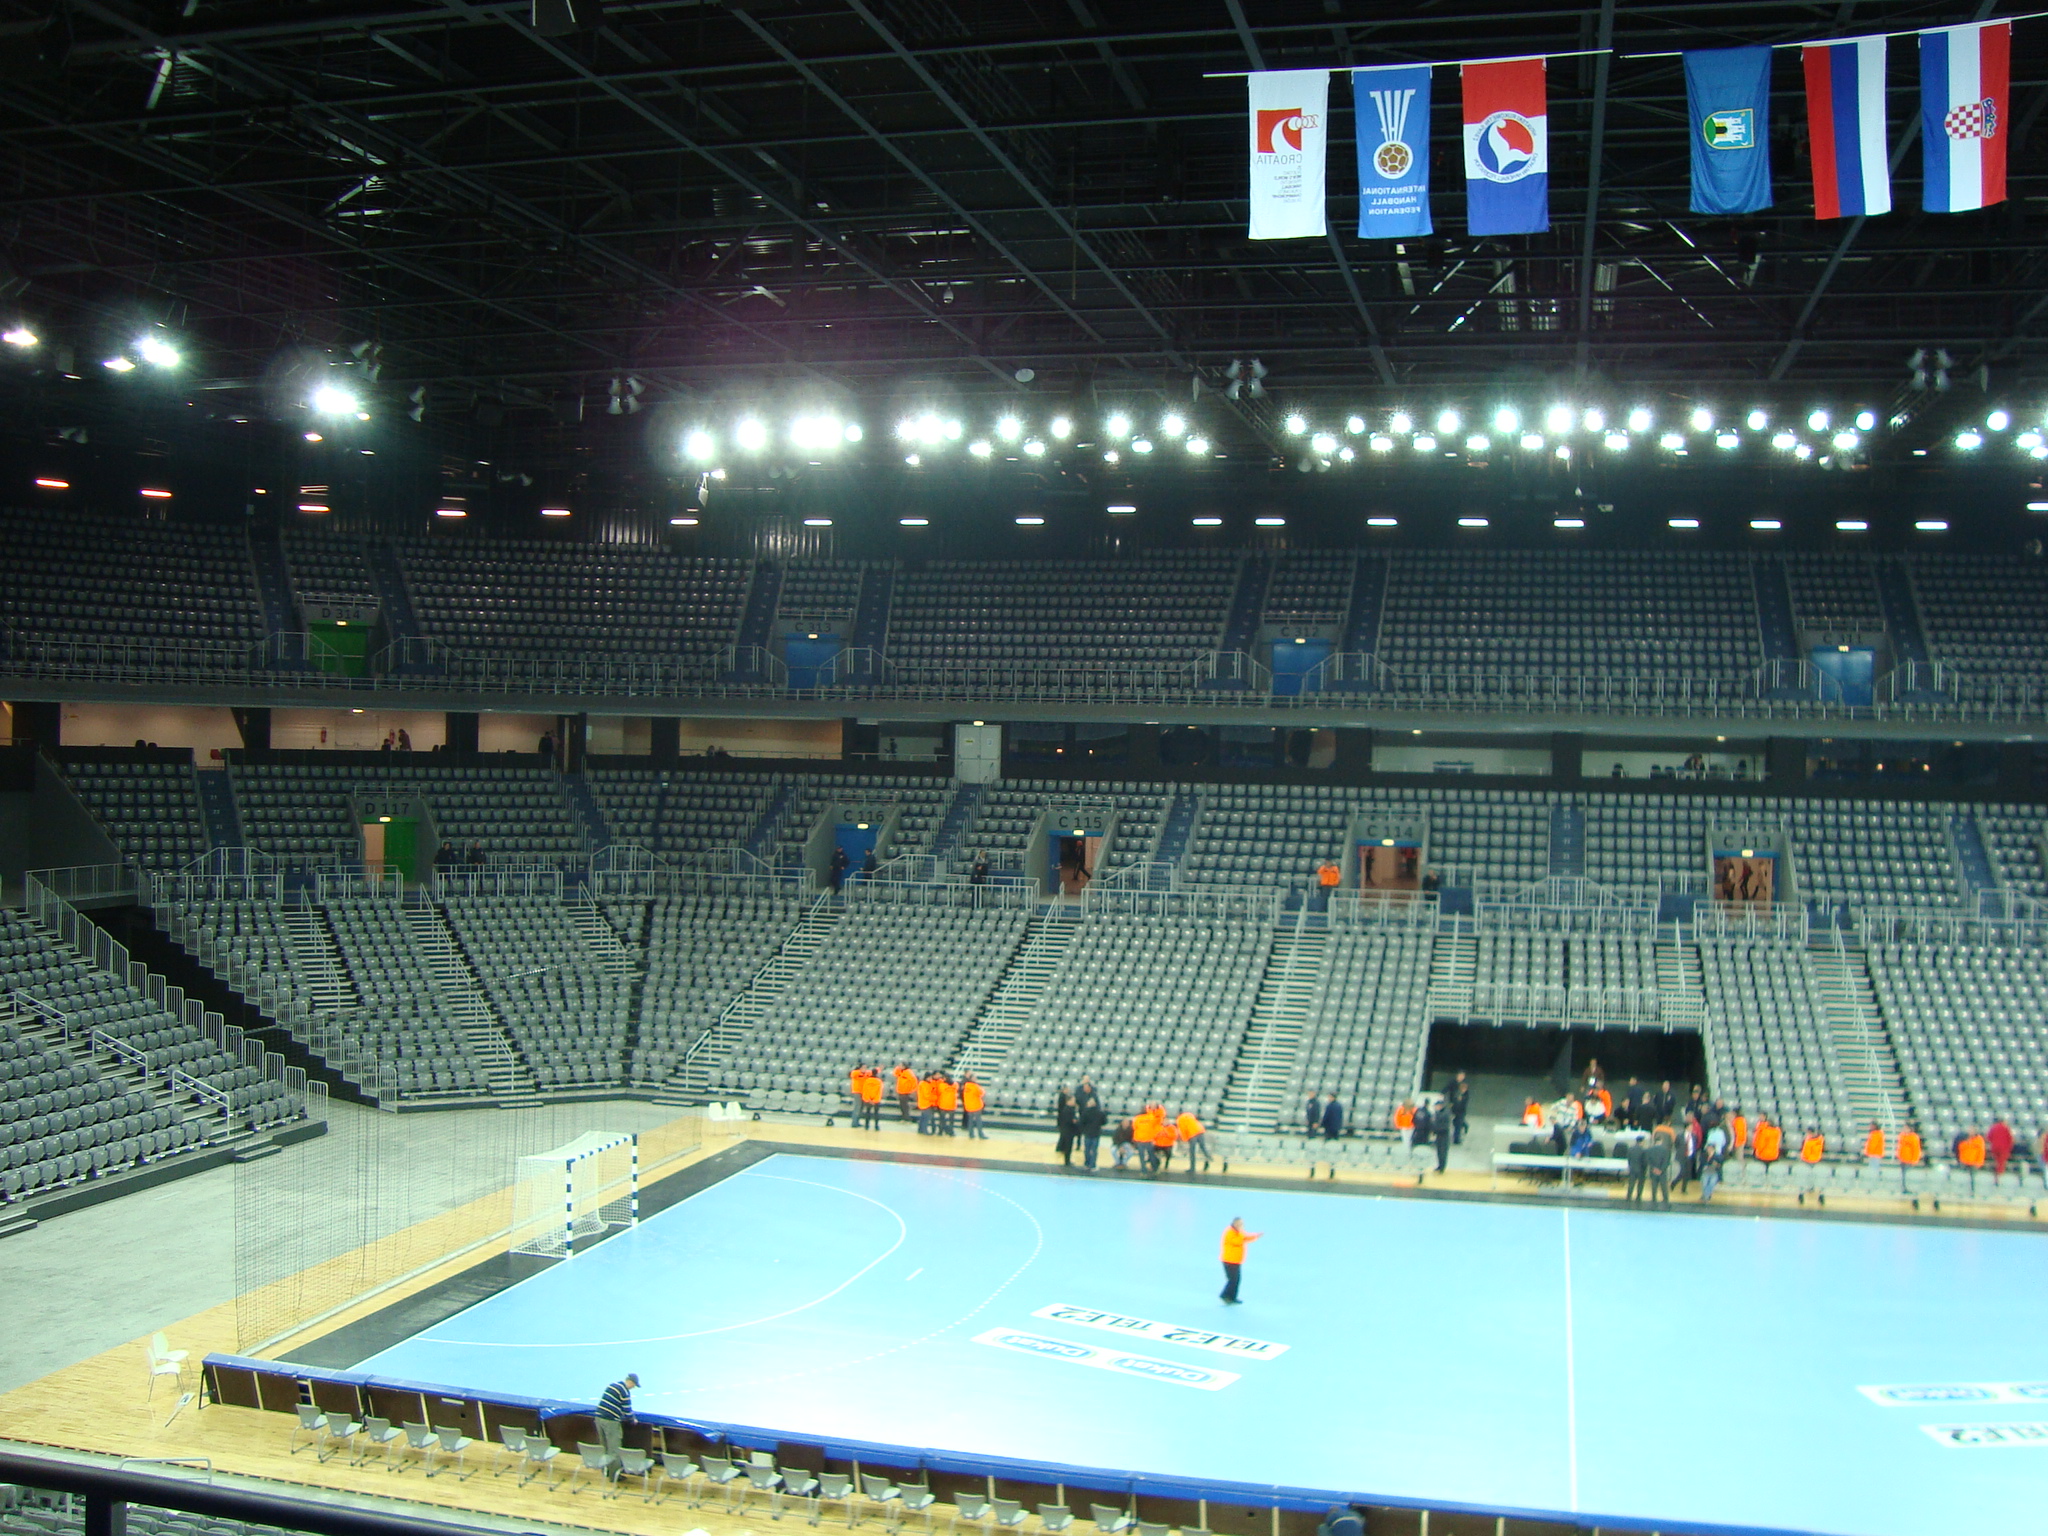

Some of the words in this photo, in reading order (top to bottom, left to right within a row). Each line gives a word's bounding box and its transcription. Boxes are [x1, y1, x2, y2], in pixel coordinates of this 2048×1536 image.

[322, 608, 331, 618] D
[336, 609, 360, 619] 314
[795, 622, 803, 632] C
[809, 622, 832, 632] 313
[1281, 627, 1290, 637] C
[365, 802, 375, 814] D
[381, 803, 409, 815] 117
[843, 810, 852, 821] C
[858, 810, 884, 822] 116
[1058, 816, 1068, 827] C
[1074, 816, 1102, 828] 115
[1367, 825, 1377, 837] C
[1384, 825, 1412, 838] 114
[1723, 835, 1734, 848] C
[1050, 1306, 1153, 1331] TELE2
[1006, 1334, 1083, 1357] Dukat
[1162, 1327, 1272, 1353] TELE2
[1121, 1357, 1204, 1382] Dukat
